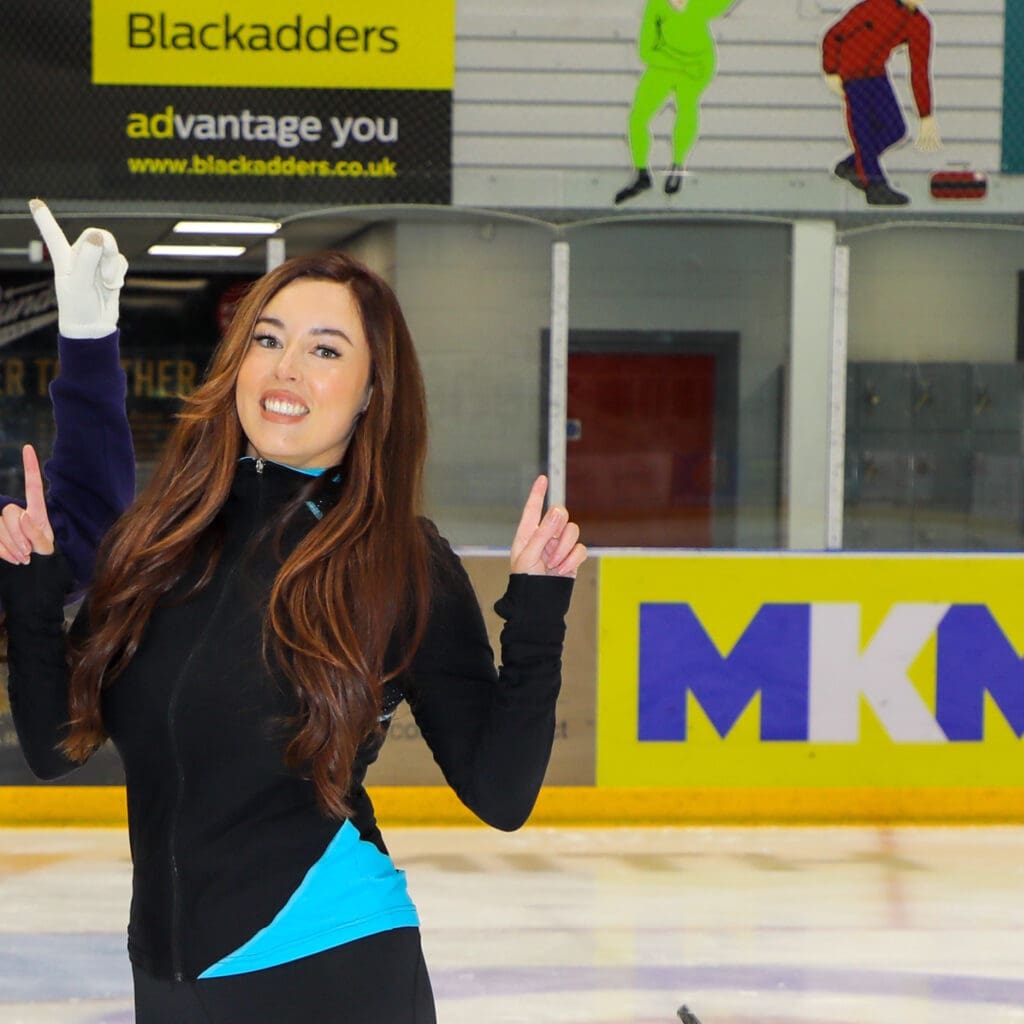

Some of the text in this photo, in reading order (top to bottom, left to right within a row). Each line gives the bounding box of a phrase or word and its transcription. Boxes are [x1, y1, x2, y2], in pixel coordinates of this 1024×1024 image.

[128, 12, 399, 53] Blackadders
[127, 105, 399, 149] advantage you
[127, 154, 397, 177] www.blackadders.co.uk
